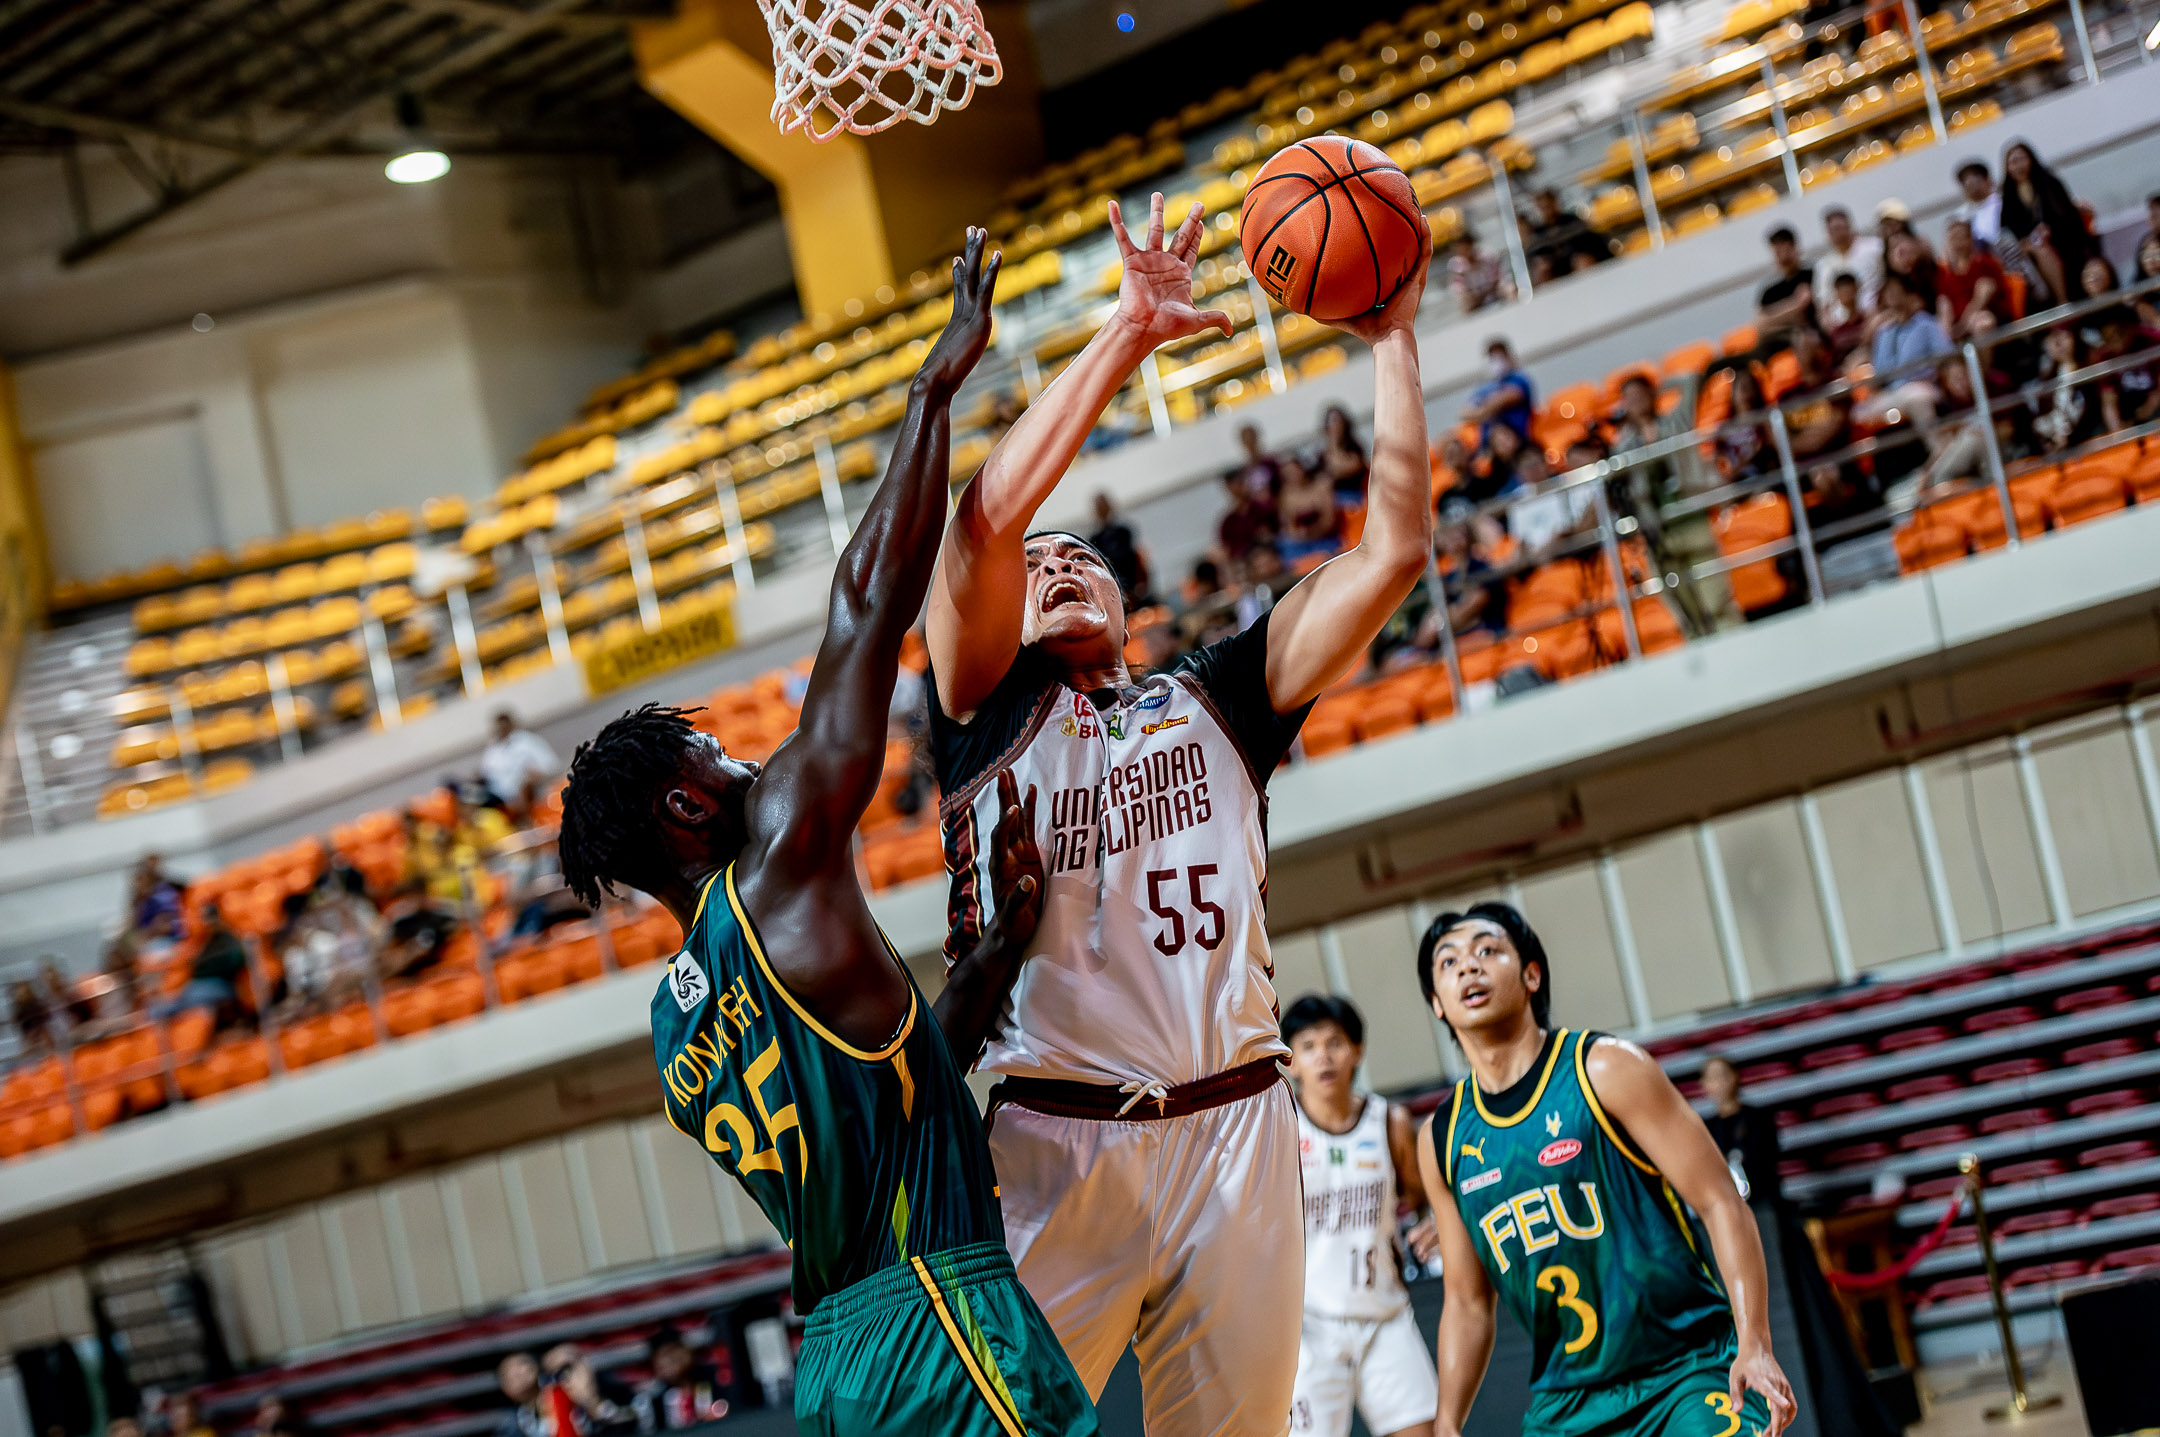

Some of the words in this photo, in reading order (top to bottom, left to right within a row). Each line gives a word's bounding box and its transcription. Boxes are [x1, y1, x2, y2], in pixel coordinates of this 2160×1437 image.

[1052, 742, 1207, 830] UNIRSIDAD
[1050, 829, 1089, 875] NG
[1146, 863, 1226, 957] 55
[683, 992, 700, 1008] UAAP
[705, 1036, 803, 1178] 25
[1479, 1182, 1604, 1275] FEU
[1536, 1265, 1598, 1354] 3
[1704, 1391, 1741, 1437] 3
